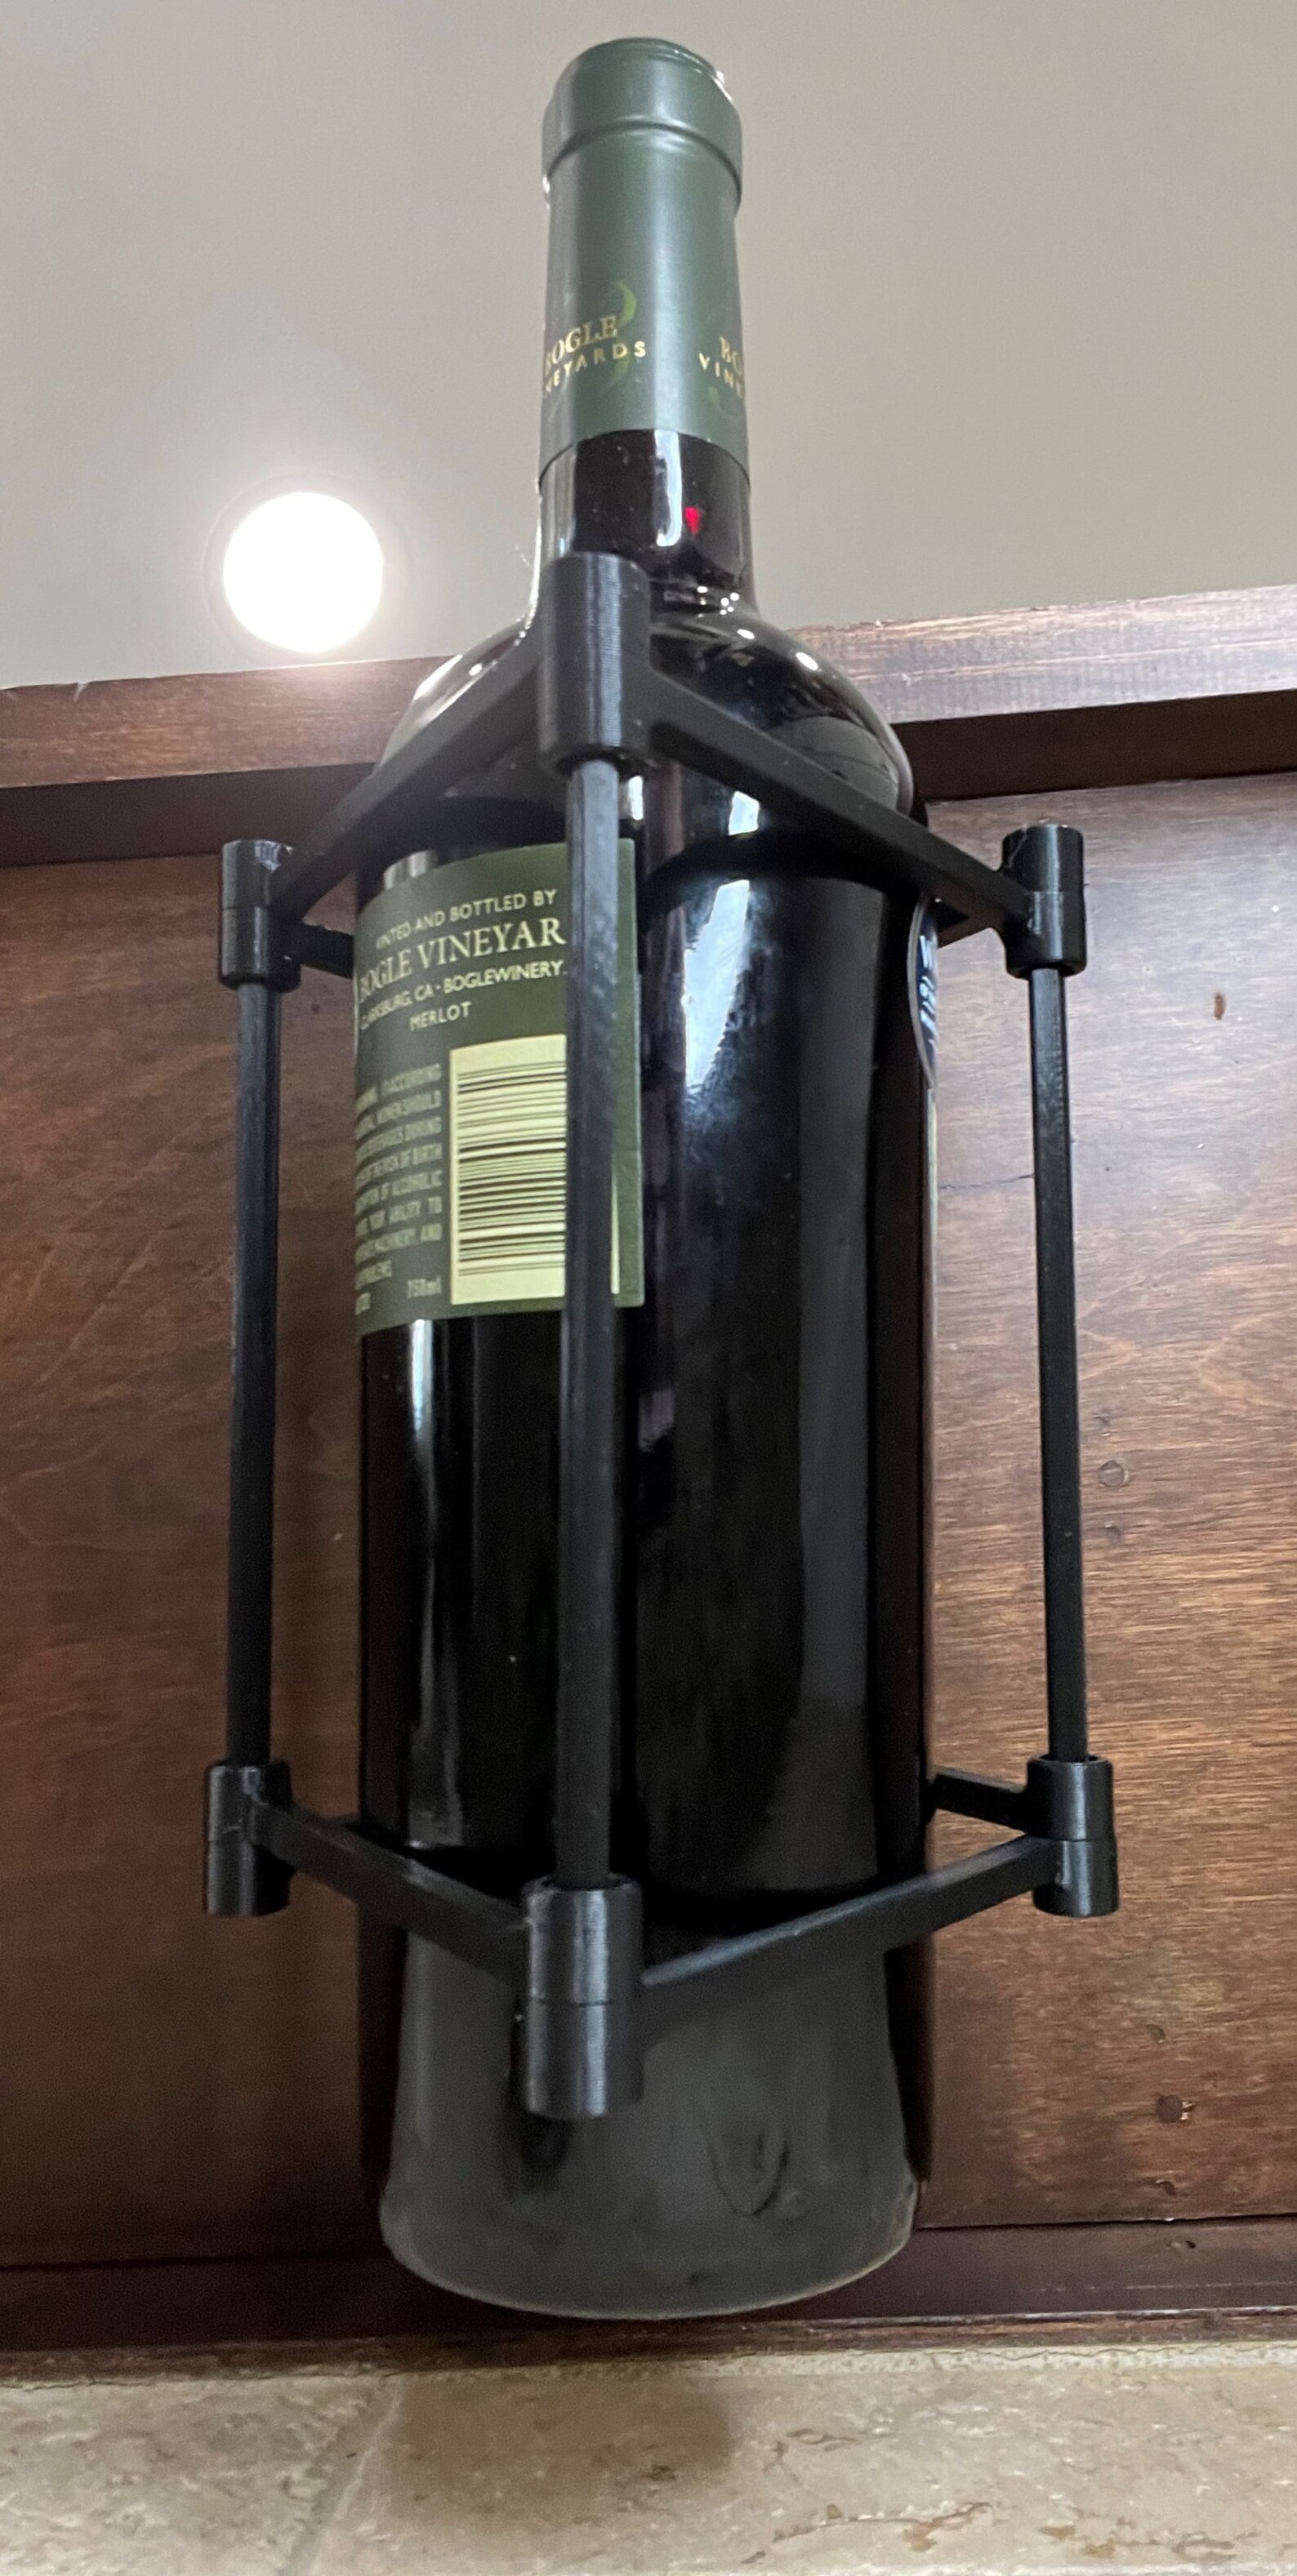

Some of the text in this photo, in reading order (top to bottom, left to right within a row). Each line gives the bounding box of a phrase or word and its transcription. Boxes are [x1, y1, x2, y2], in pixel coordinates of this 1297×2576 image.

[415, 910, 446, 932] AND
[450, 893, 526, 923] BOTTLED
[533, 888, 557, 907] BY
[410, 1000, 472, 1031] MERLOT
